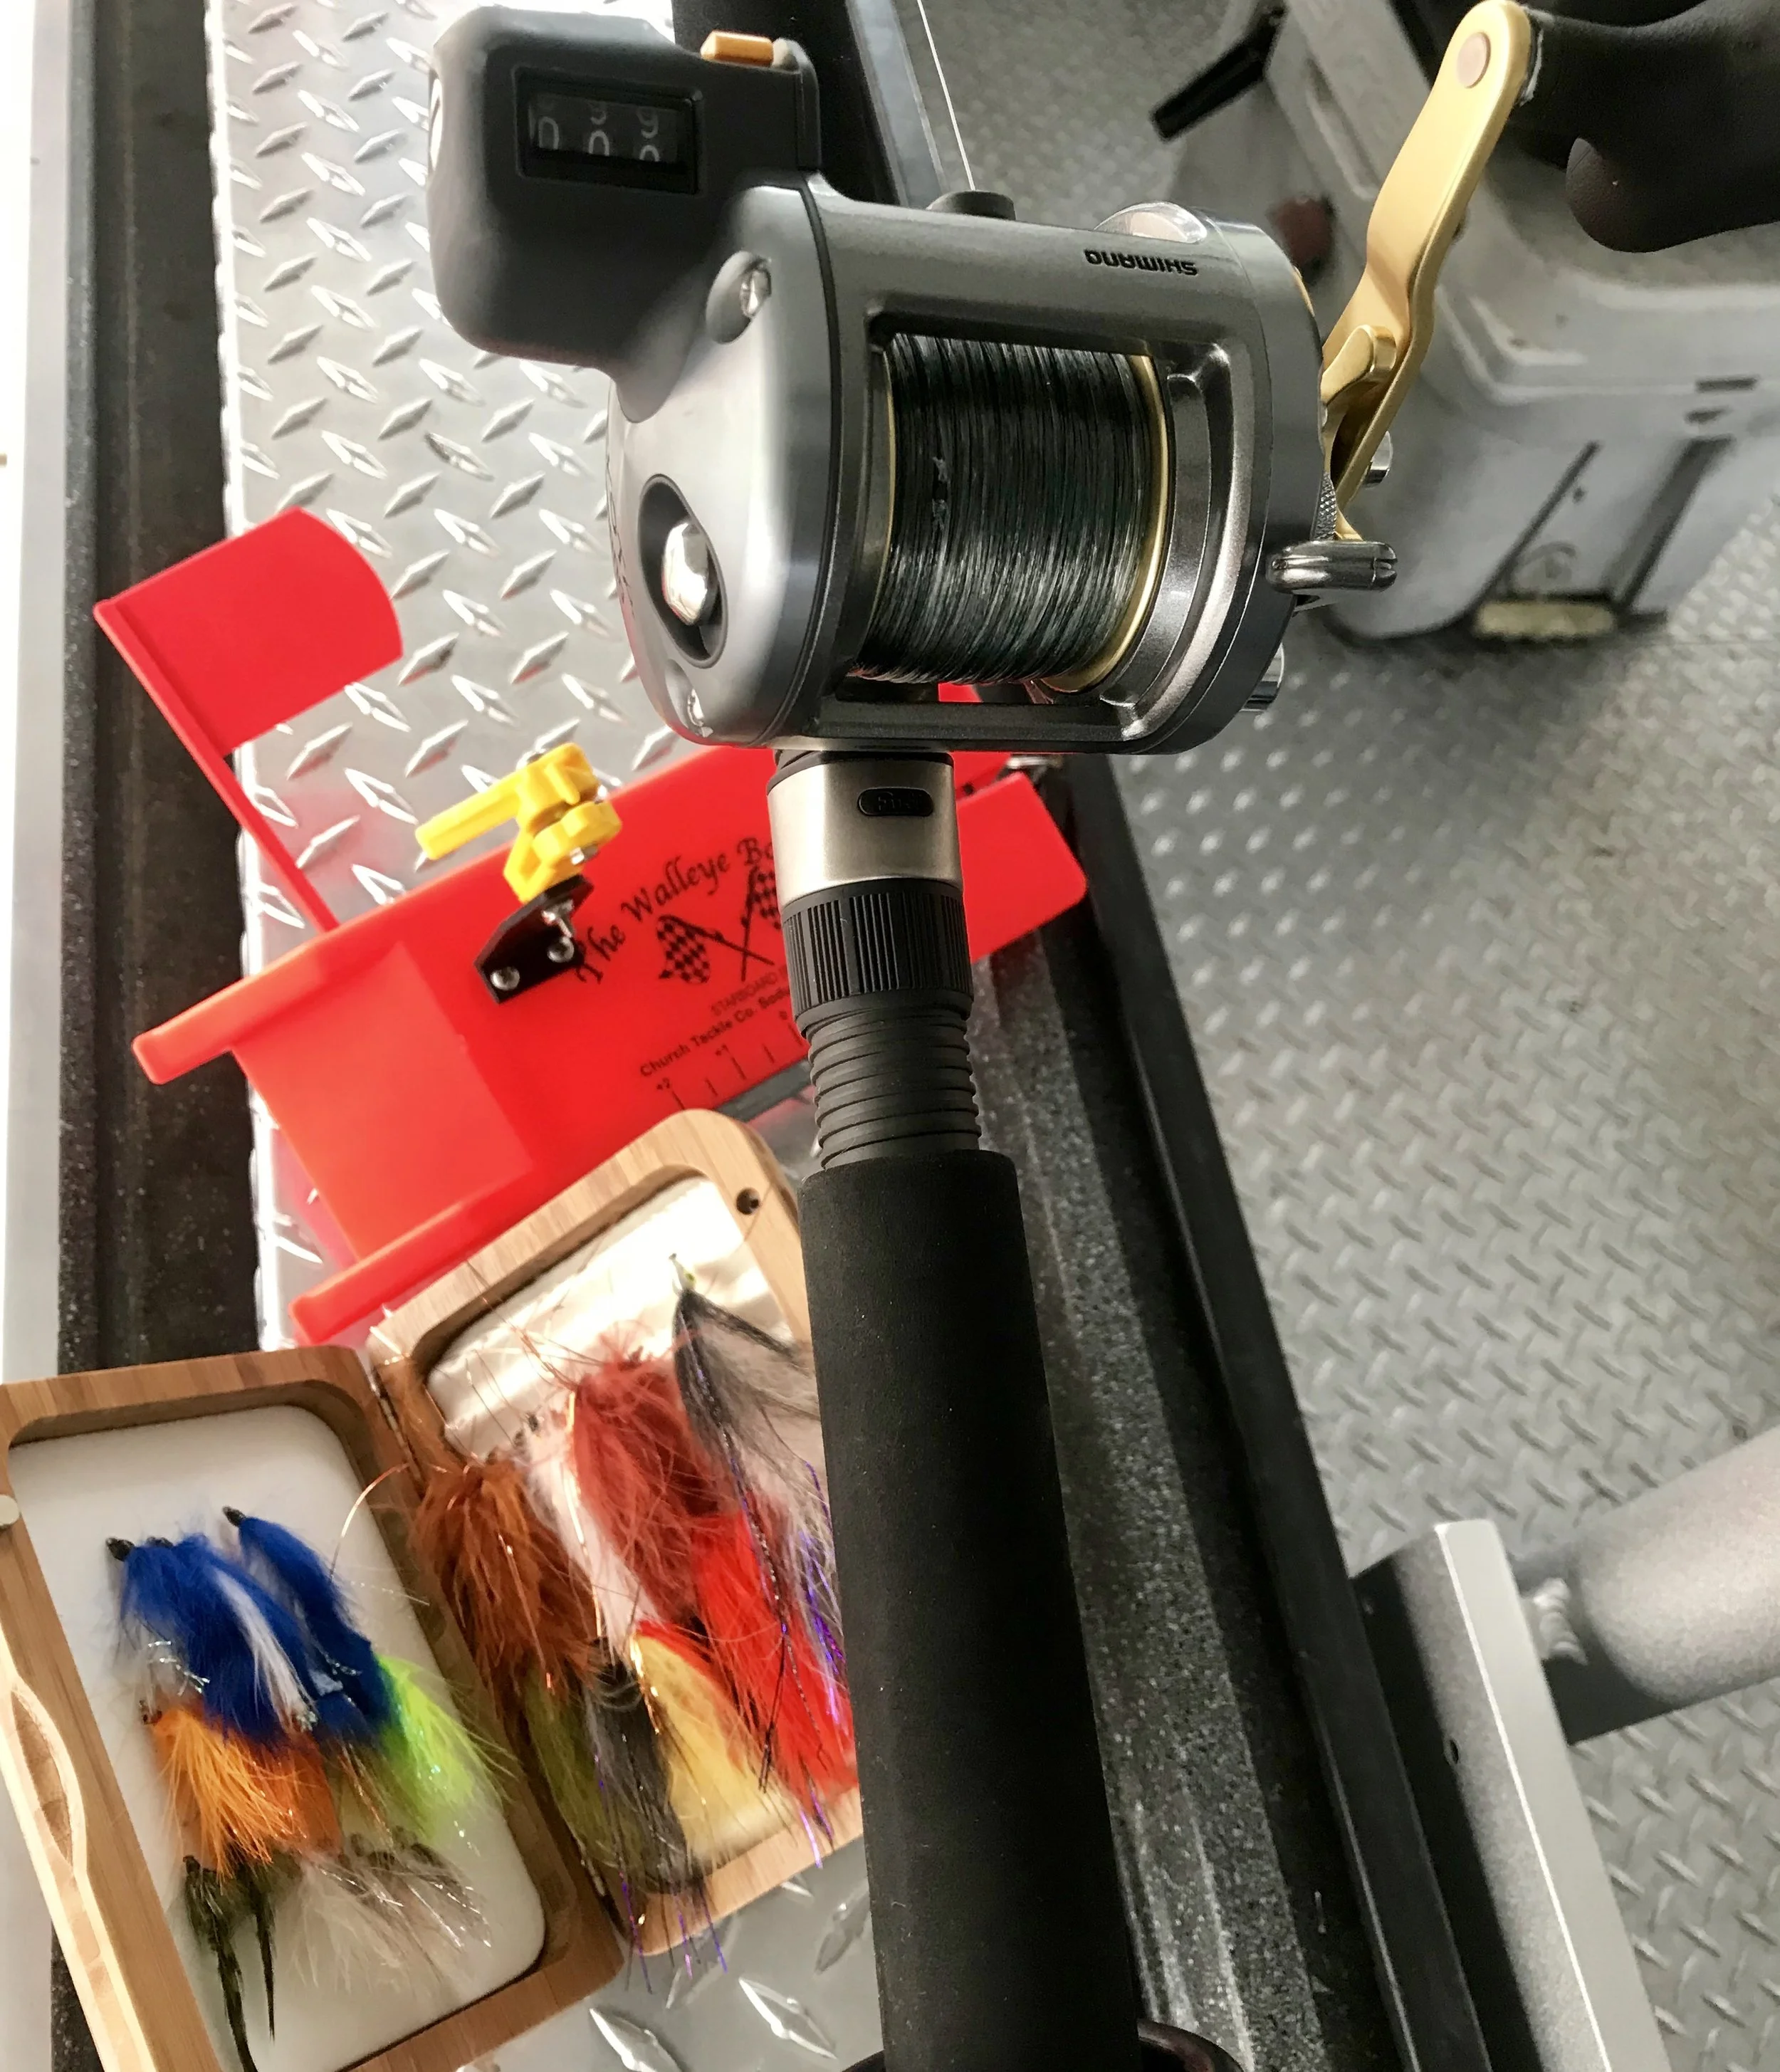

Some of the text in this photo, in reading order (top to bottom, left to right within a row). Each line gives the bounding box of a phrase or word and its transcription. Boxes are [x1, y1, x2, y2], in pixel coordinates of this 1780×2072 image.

[1084, 248, 1198, 276] SHIMANO
[575, 924, 626, 985] The
[620, 854, 731, 923] Walleye
[639, 1045, 691, 1077] Church
[691, 1020, 733, 1047] Tackle
